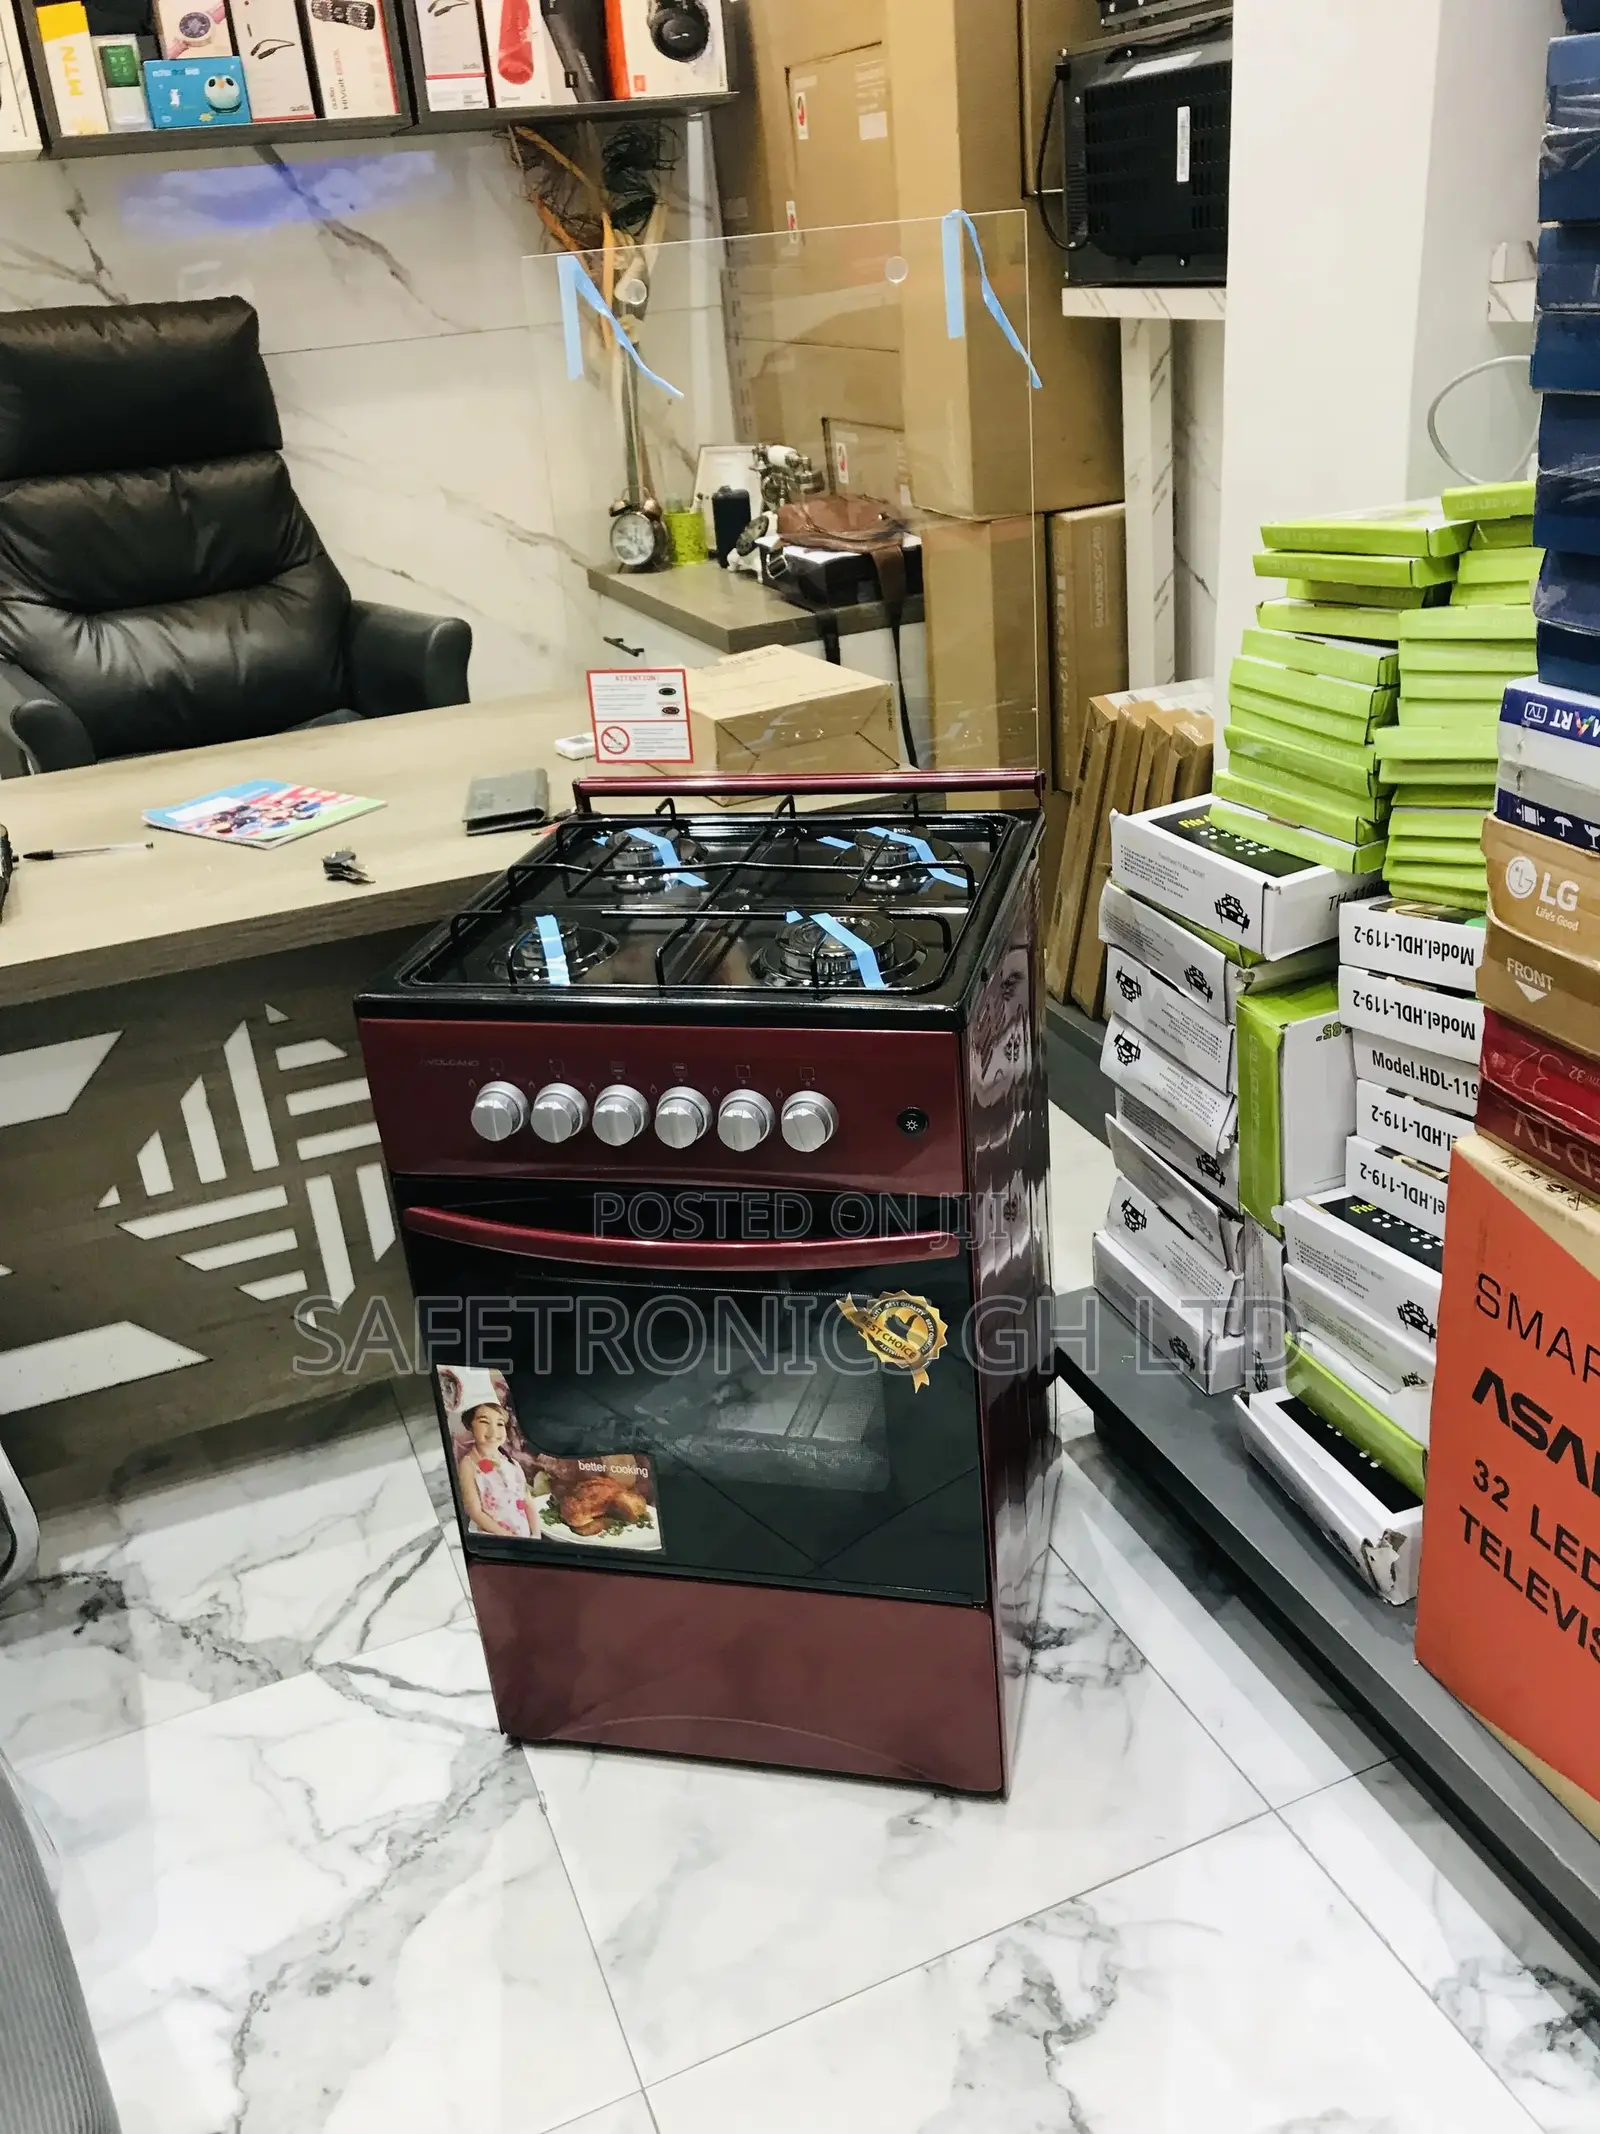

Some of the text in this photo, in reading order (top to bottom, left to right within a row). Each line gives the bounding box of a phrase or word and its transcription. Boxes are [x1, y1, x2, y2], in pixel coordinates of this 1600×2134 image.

[60, 46, 84, 96] MTN
[1528, 707, 1545, 720] TV
[1540, 872, 1580, 911] LG
[1536, 906, 1579, 931] Life's Good
[1354, 925, 1475, 966] Model.HDL-119-2
[1507, 957, 1554, 991] FRONT
[1352, 990, 1476, 1041] Model.HDL-119-2
[859, 1316, 917, 1360] BEST CHOICE
[578, 1460, 649, 1478] better cooking
[1472, 1458, 1509, 1512] 32
